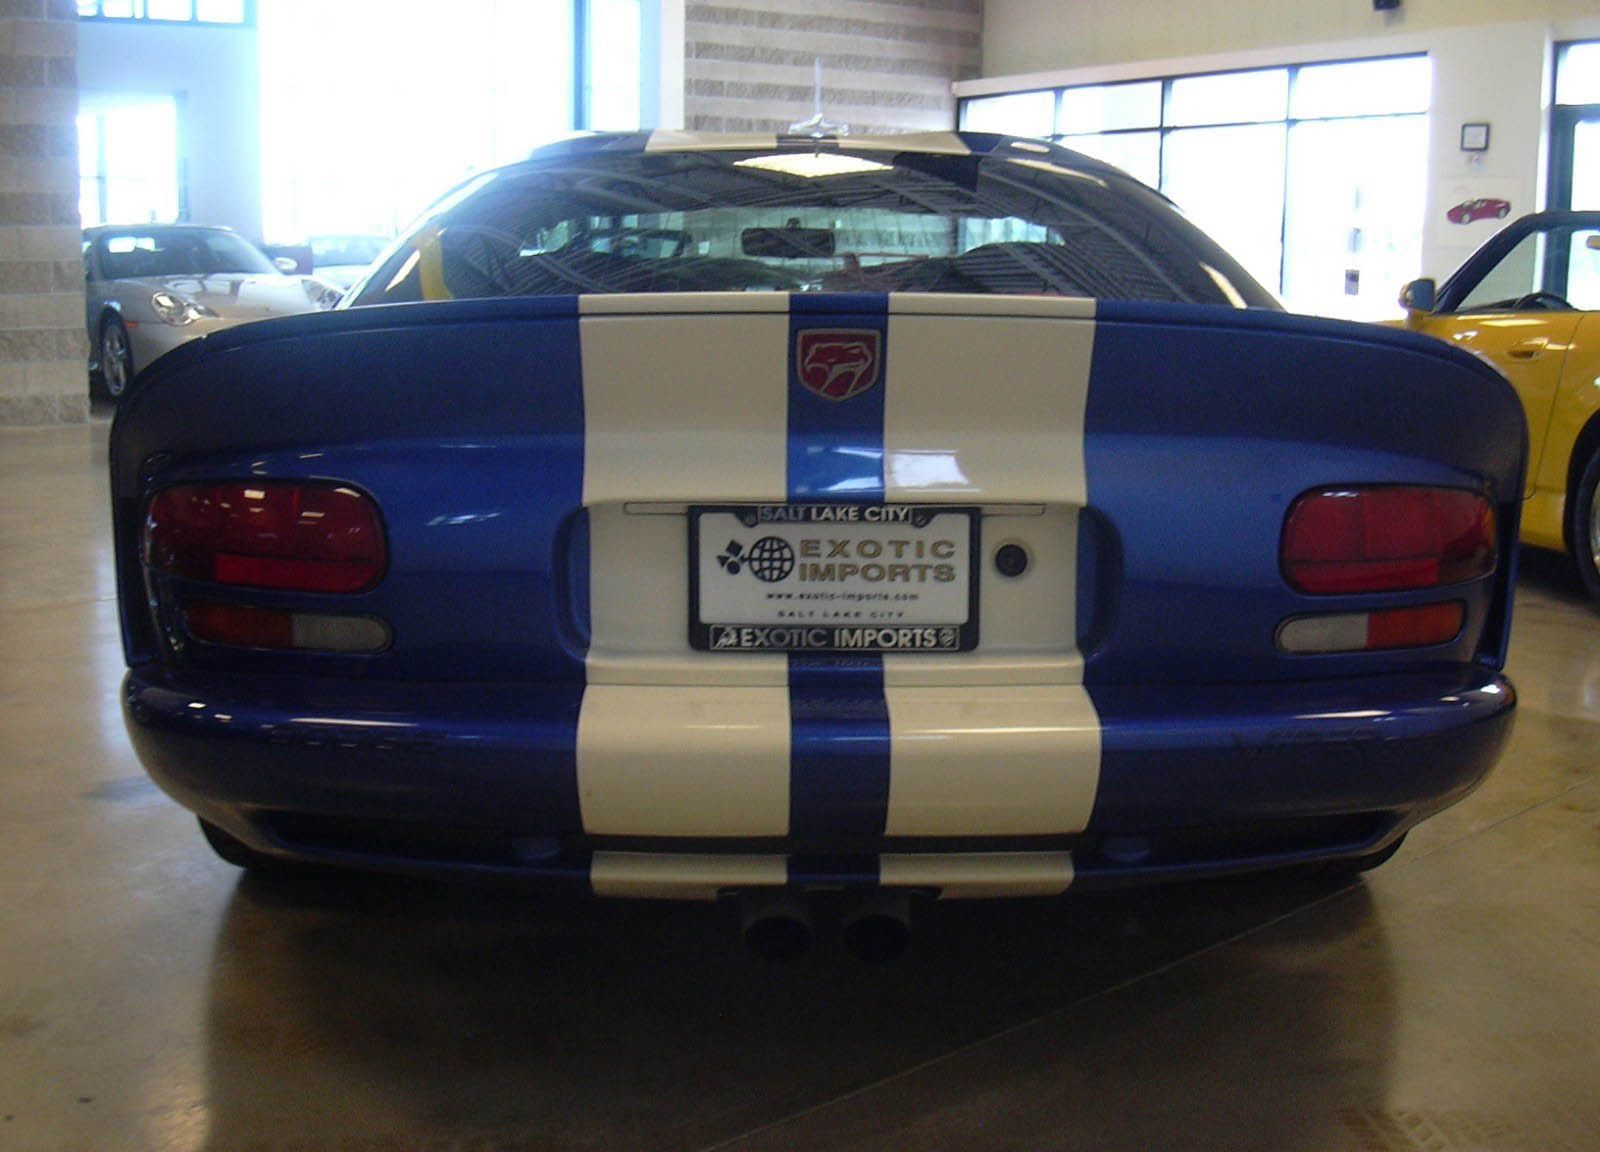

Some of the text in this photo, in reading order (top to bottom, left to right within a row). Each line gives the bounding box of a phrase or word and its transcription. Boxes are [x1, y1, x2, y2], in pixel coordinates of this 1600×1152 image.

[760, 506, 909, 521] SALT LAKE CITY
[799, 538, 956, 559] EXOTIC
[799, 563, 957, 583] IMPORTS
[777, 610, 904, 618] SALT LAKE CITY
[741, 628, 937, 648] EXOTIC IMPORTS
